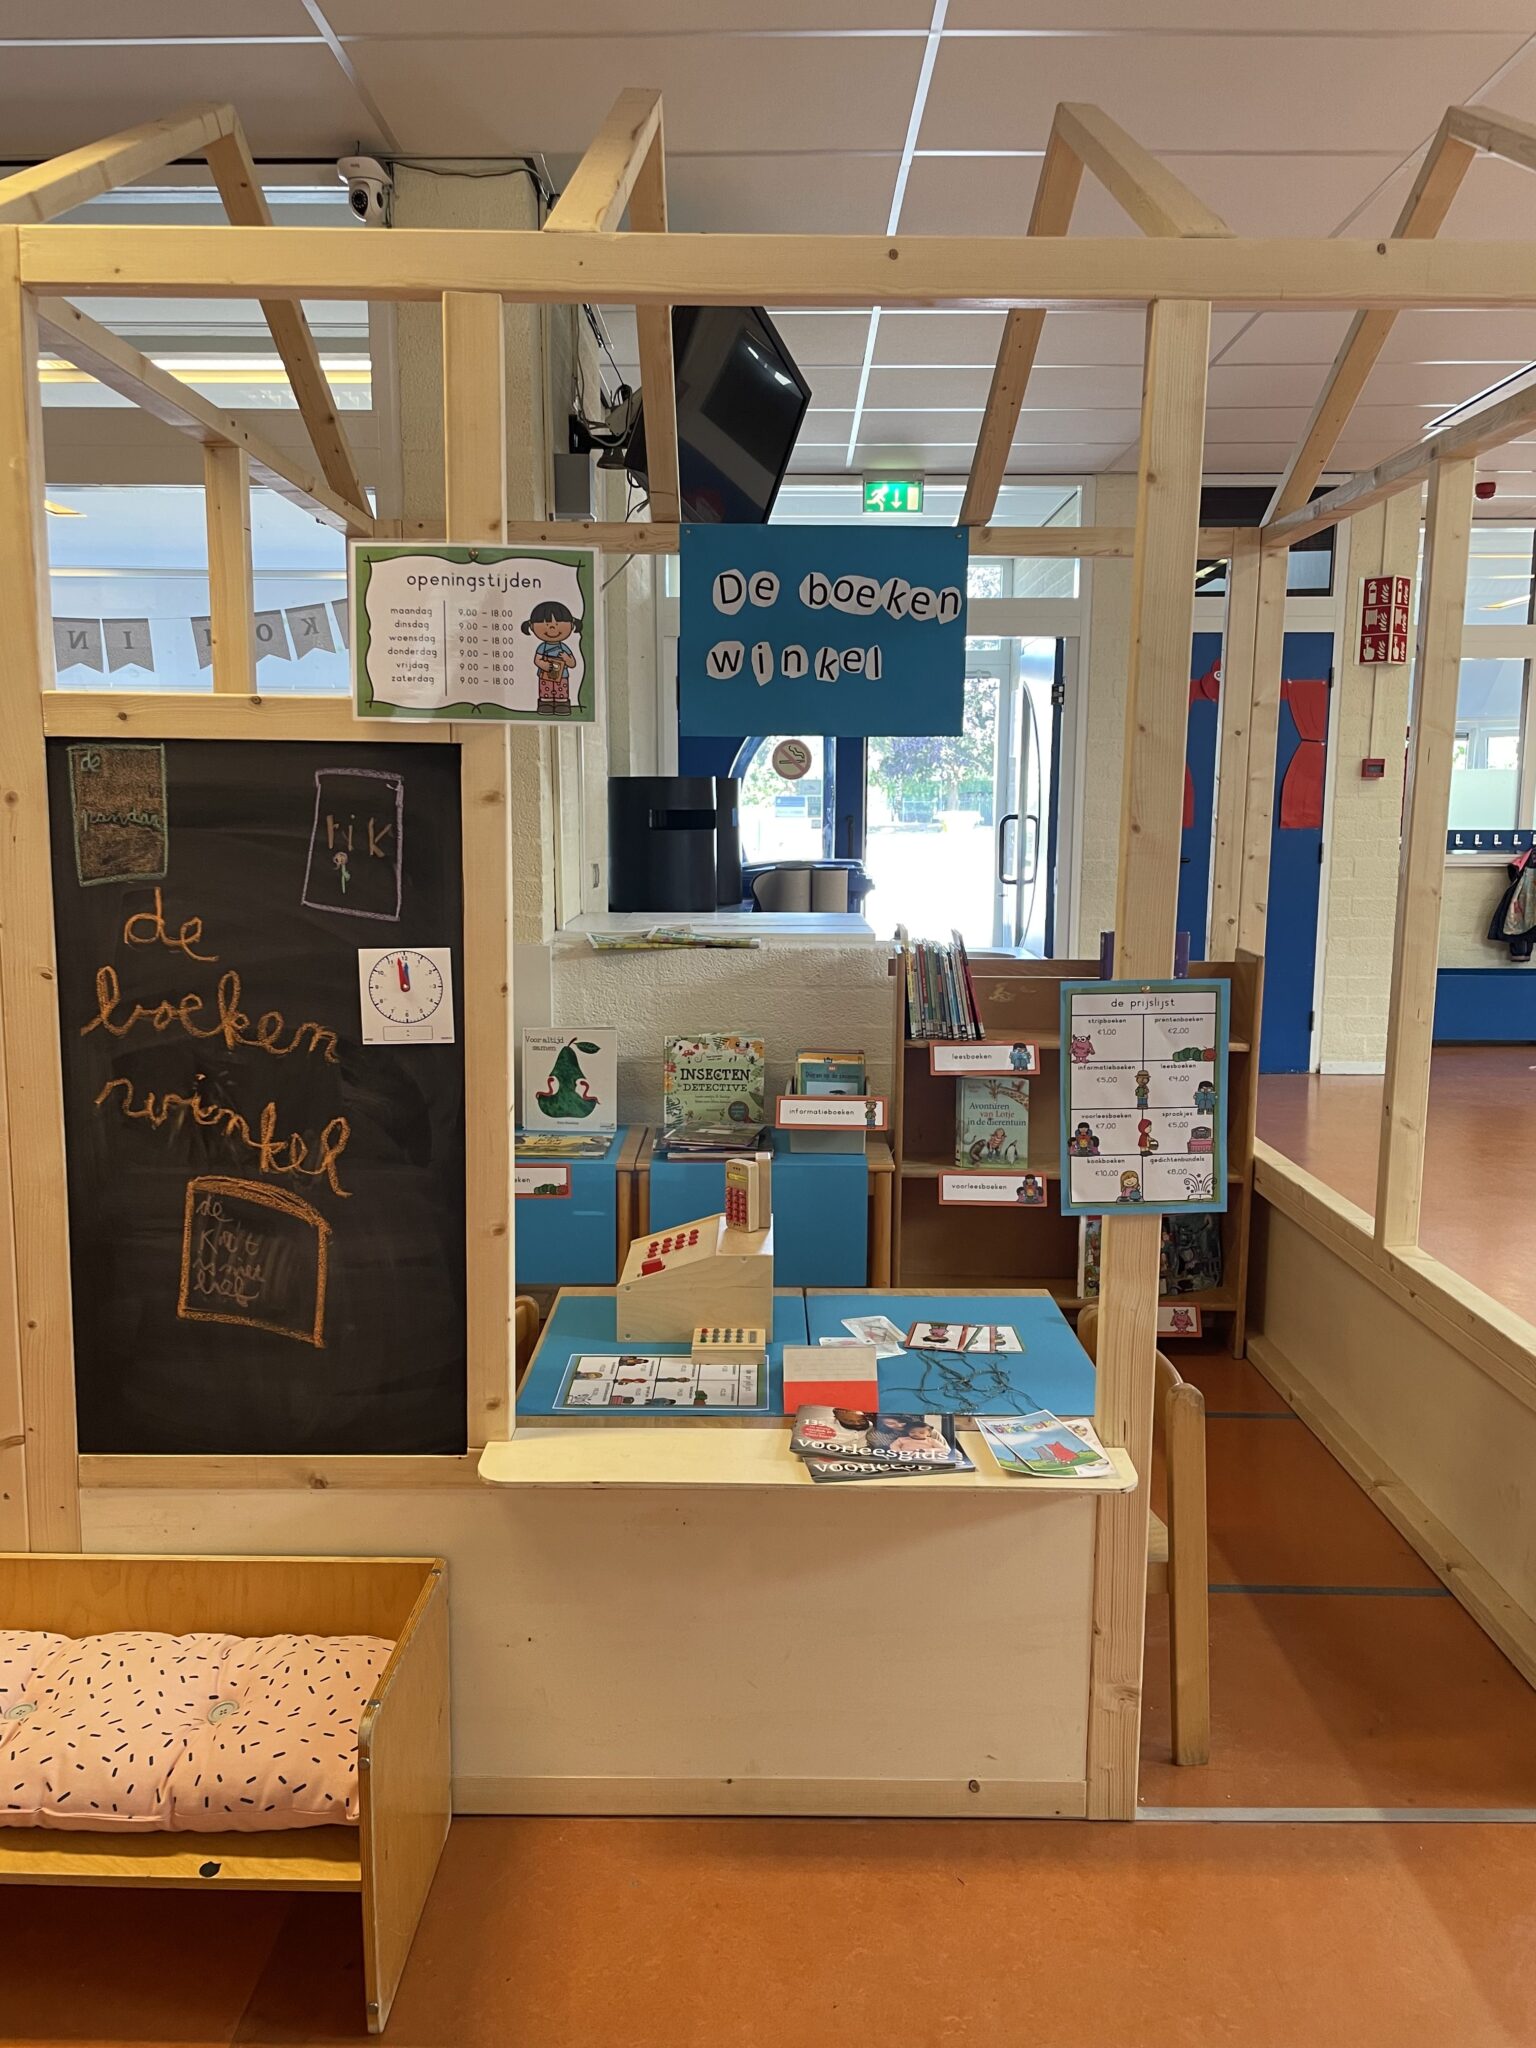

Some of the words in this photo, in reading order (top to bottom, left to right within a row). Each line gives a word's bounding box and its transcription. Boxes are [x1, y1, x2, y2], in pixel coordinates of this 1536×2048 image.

[406, 572, 542, 593] openingstijden
[719, 573, 775, 604] De
[808, 573, 960, 615] boeken
[390, 607, 432, 617] maandag
[458, 608, 477, 617] 9.00
[394, 620, 429, 631] dinsdag
[389, 633, 436, 644] woensdag
[387, 647, 437, 658] donderdag
[396, 661, 429, 672] vrijdag
[711, 644, 880, 681] winkel
[391, 674, 435, 685] zaterdag
[124, 886, 220, 961] de
[1110, 999, 1124, 1008] de
[1130, 998, 1176, 1013] prijslijst
[80, 965, 340, 1064] boeken
[1154, 1016, 1204, 1024] prentenboeken
[1088, 1017, 1127, 1025] stripboeken
[952, 1053, 993, 1061] leesboeken
[680, 1068, 751, 1081] INSECTEN
[683, 1083, 748, 1092] DETECTIVE
[789, 1107, 855, 1116] informatieboeken
[969, 1102, 1010, 1110] Avonturen
[995, 1110, 1015, 1119] Lotje
[1162, 1110, 1193, 1118] sprookjes
[94, 1073, 352, 1197] winkel
[952, 1183, 1007, 1191] voorleesboeken
[797, 1438, 950, 1462] voorleesgids
